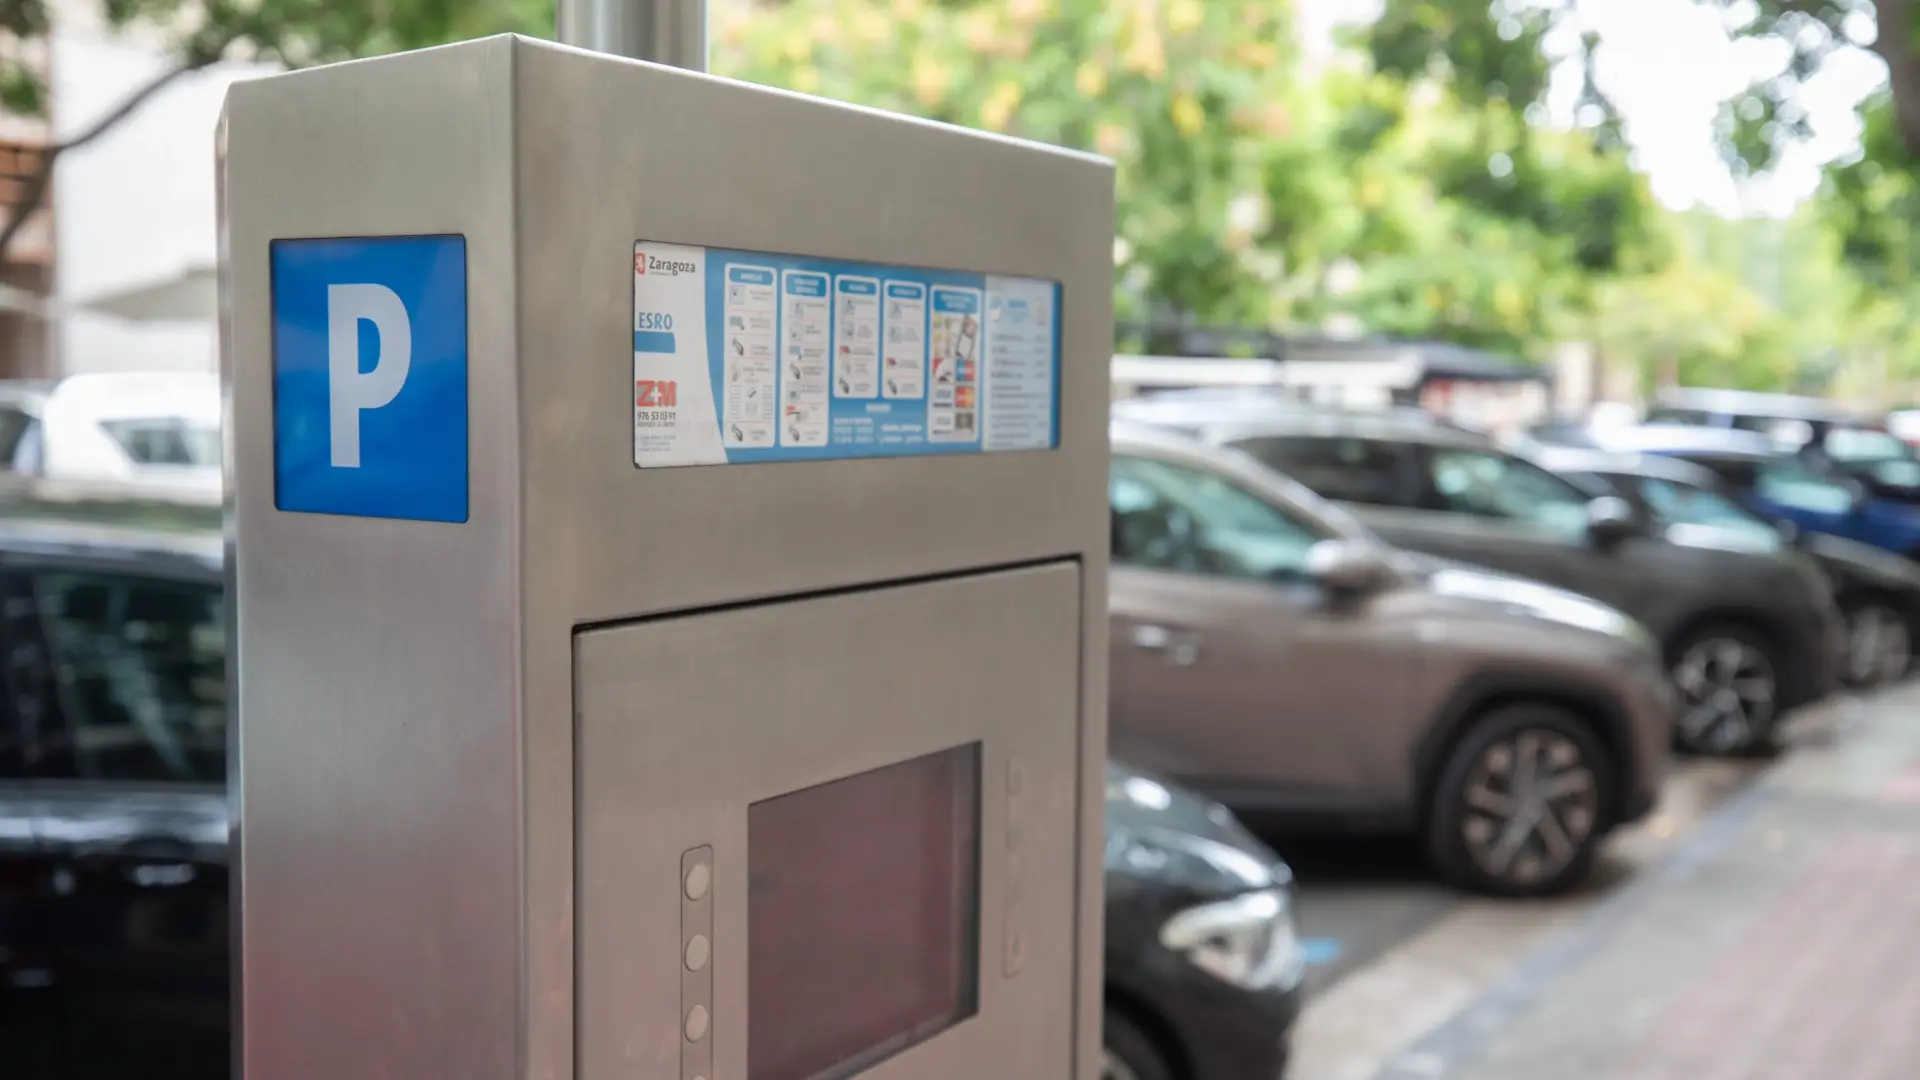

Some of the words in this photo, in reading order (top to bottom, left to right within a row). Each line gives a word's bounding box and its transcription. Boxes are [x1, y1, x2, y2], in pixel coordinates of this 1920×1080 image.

[649, 256, 696, 276] Zaragoza
[639, 312, 673, 330] ESRO
[328, 283, 411, 468] P
[637, 411, 650, 420] 976
